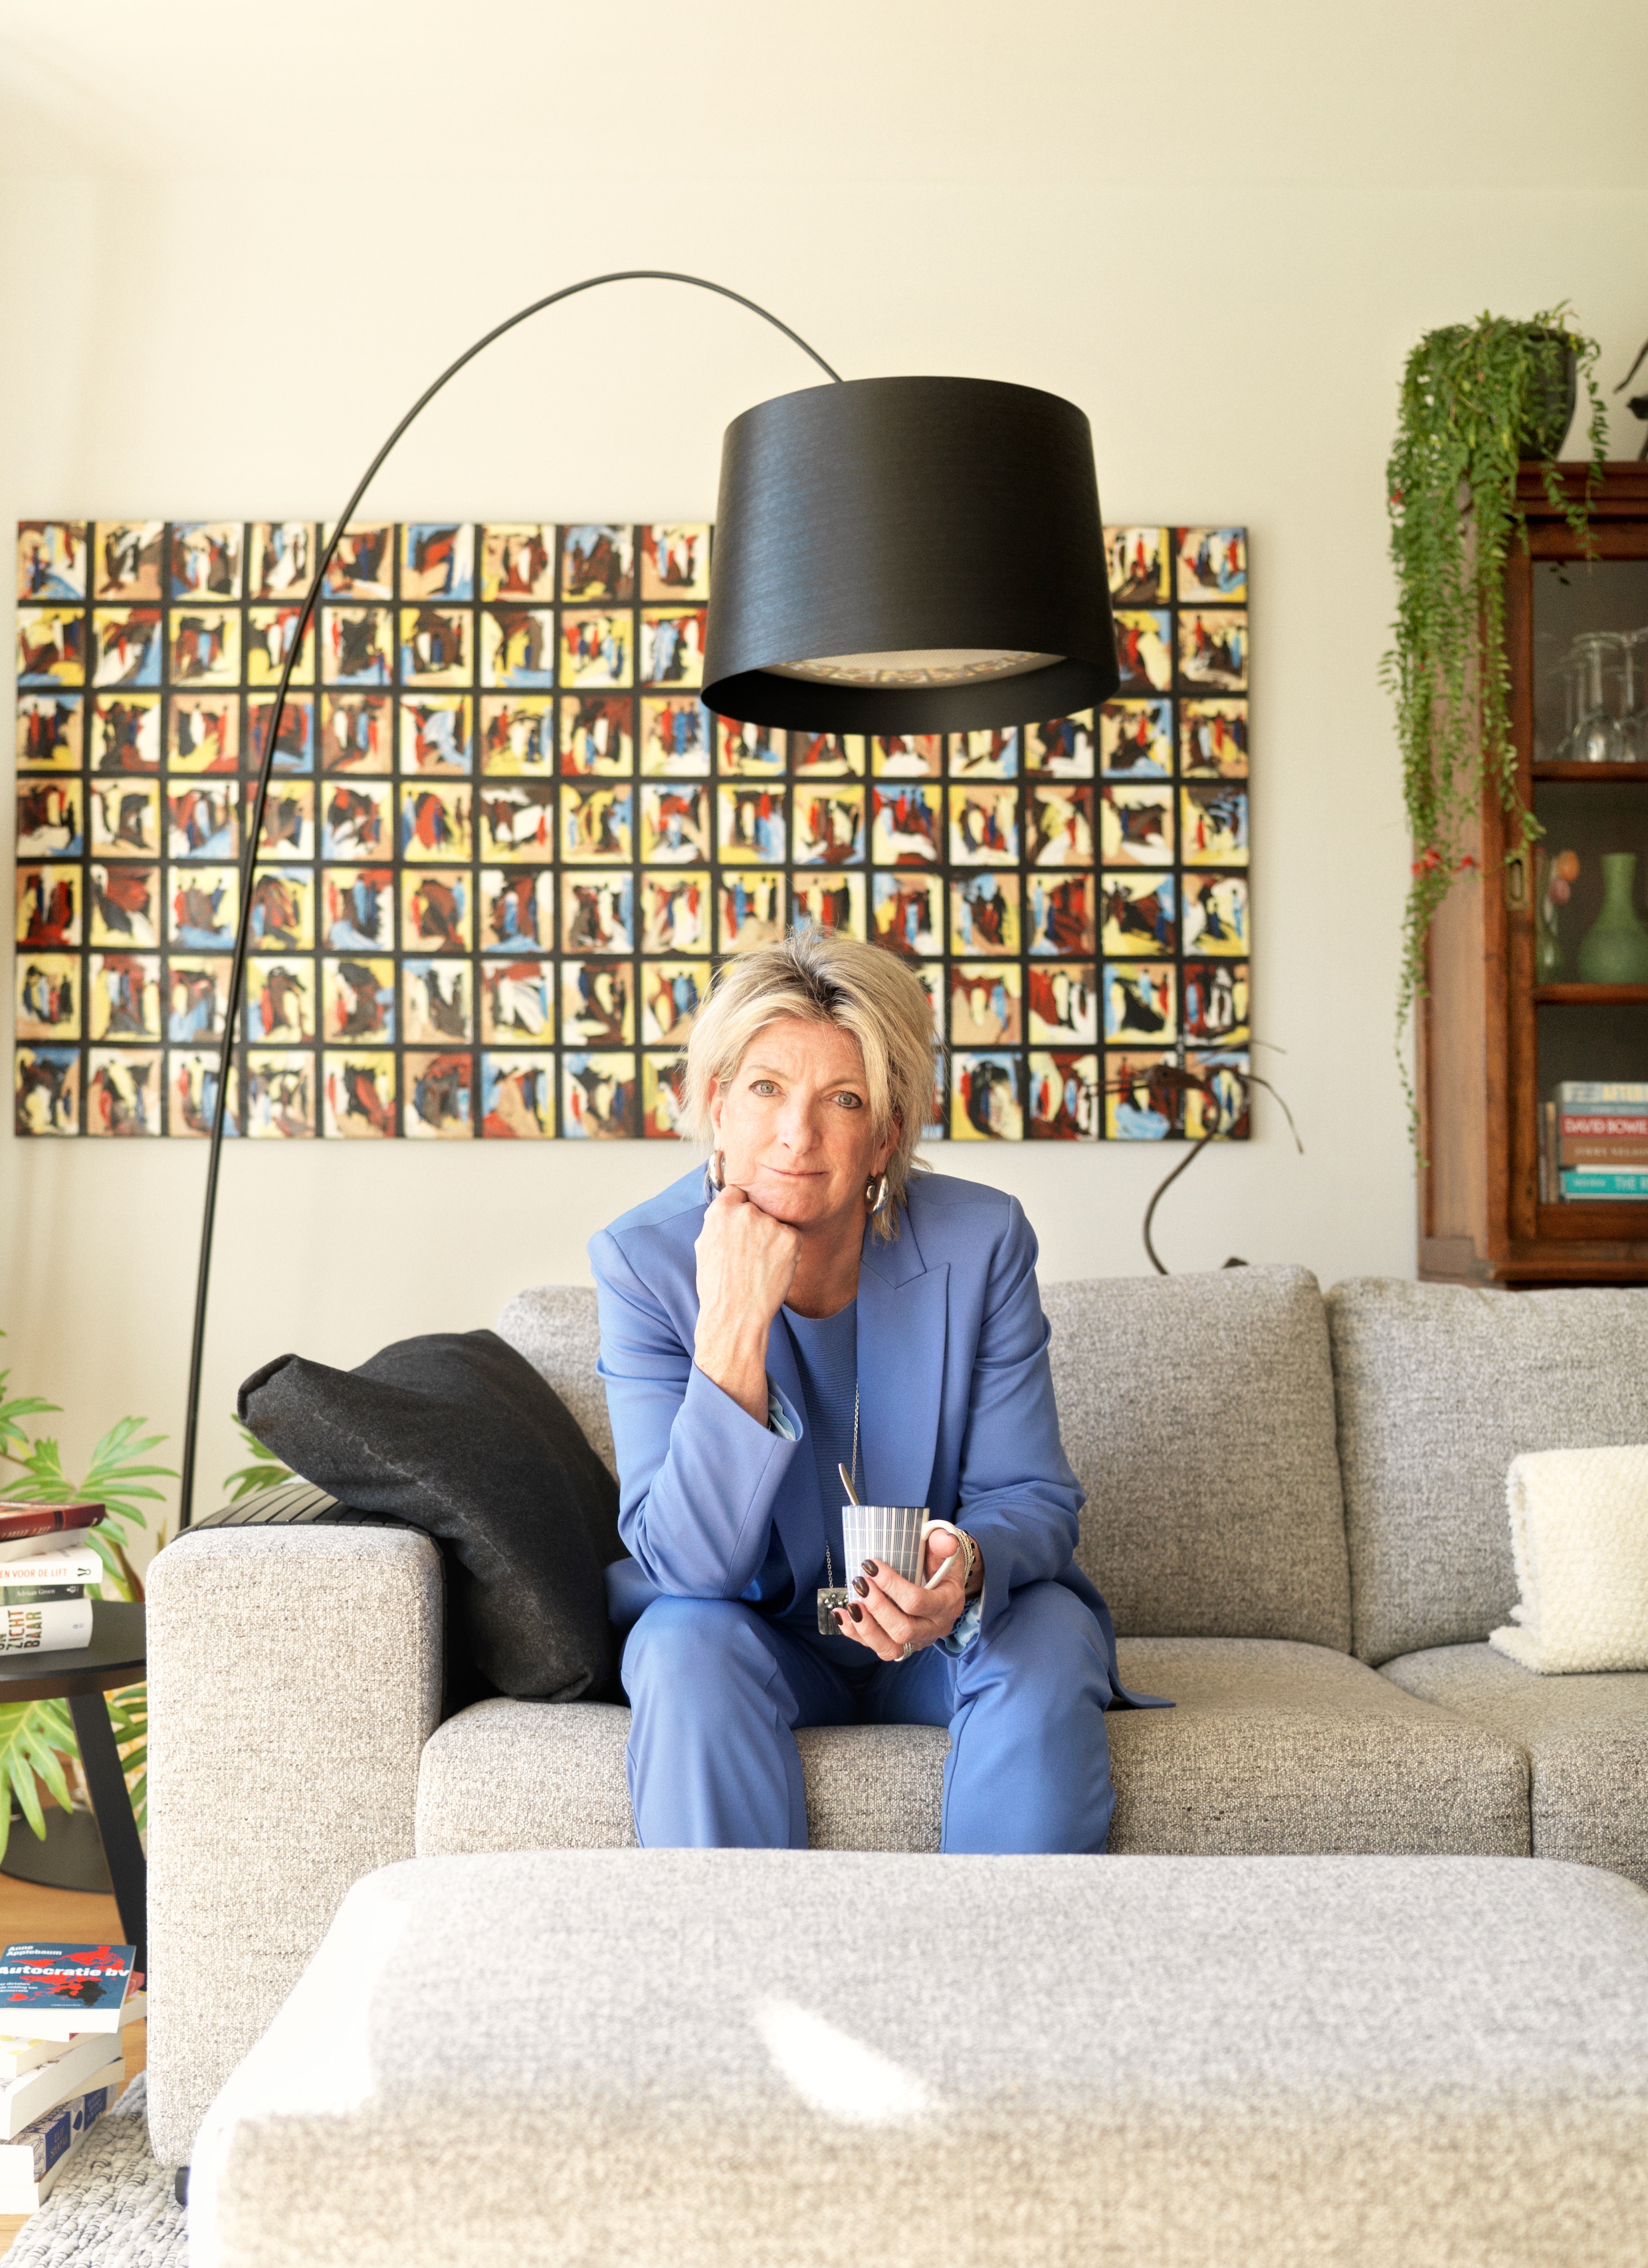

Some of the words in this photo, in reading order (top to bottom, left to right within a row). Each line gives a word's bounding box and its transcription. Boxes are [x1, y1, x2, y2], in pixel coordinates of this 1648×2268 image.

[1564, 1118, 1605, 1134] DAVID
[1607, 1118, 1647, 1135] BOWIE
[13, 1569, 35, 1578] VOOR
[51, 1568, 68, 1577] LIFT
[6, 1610, 25, 1650] ZICHT
[24, 1611, 42, 1648] BAAR
[0, 1966, 102, 1976] Autocratie
[105, 1968, 130, 1976] bv
